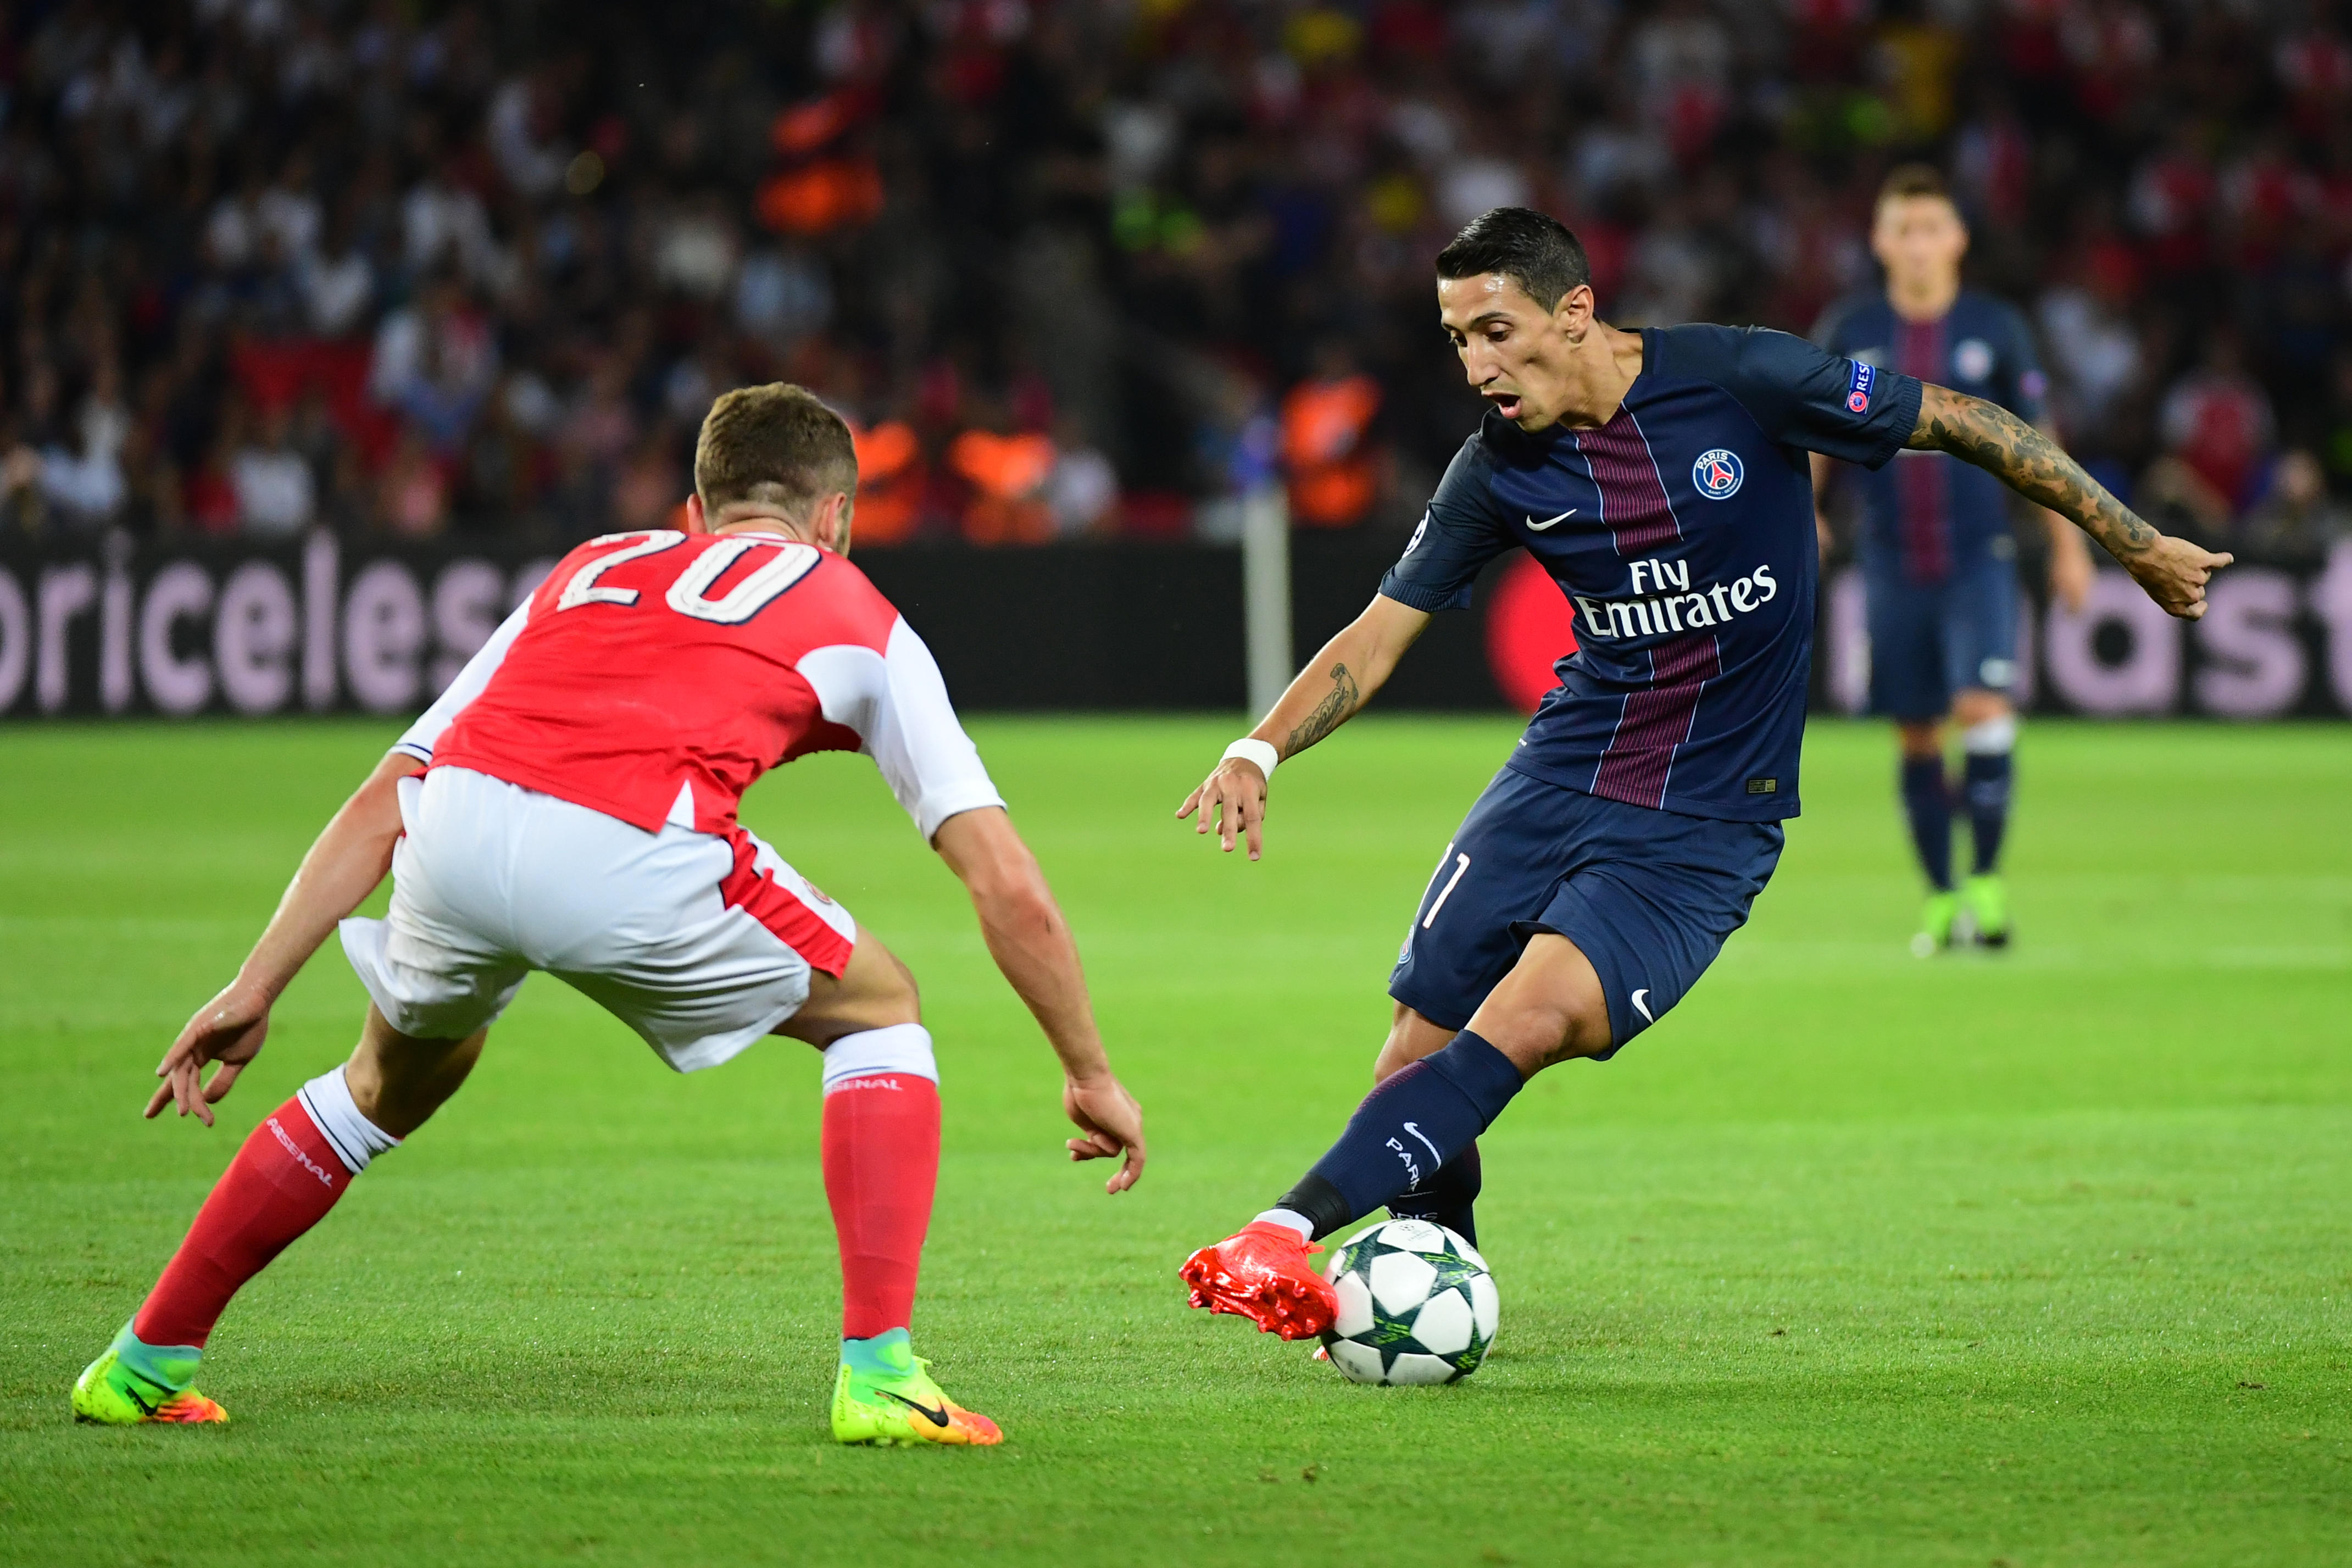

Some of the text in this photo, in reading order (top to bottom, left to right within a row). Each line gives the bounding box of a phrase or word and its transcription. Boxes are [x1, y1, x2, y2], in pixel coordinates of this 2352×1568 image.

[1697, 452, 1728, 470] PARIS
[555, 530, 822, 625] 20
[1573, 564, 1777, 638] Emirates
[1628, 558, 1690, 594] Fly
[0, 525, 553, 716] riceles
[266, 1117, 332, 1189] ARSENAL
